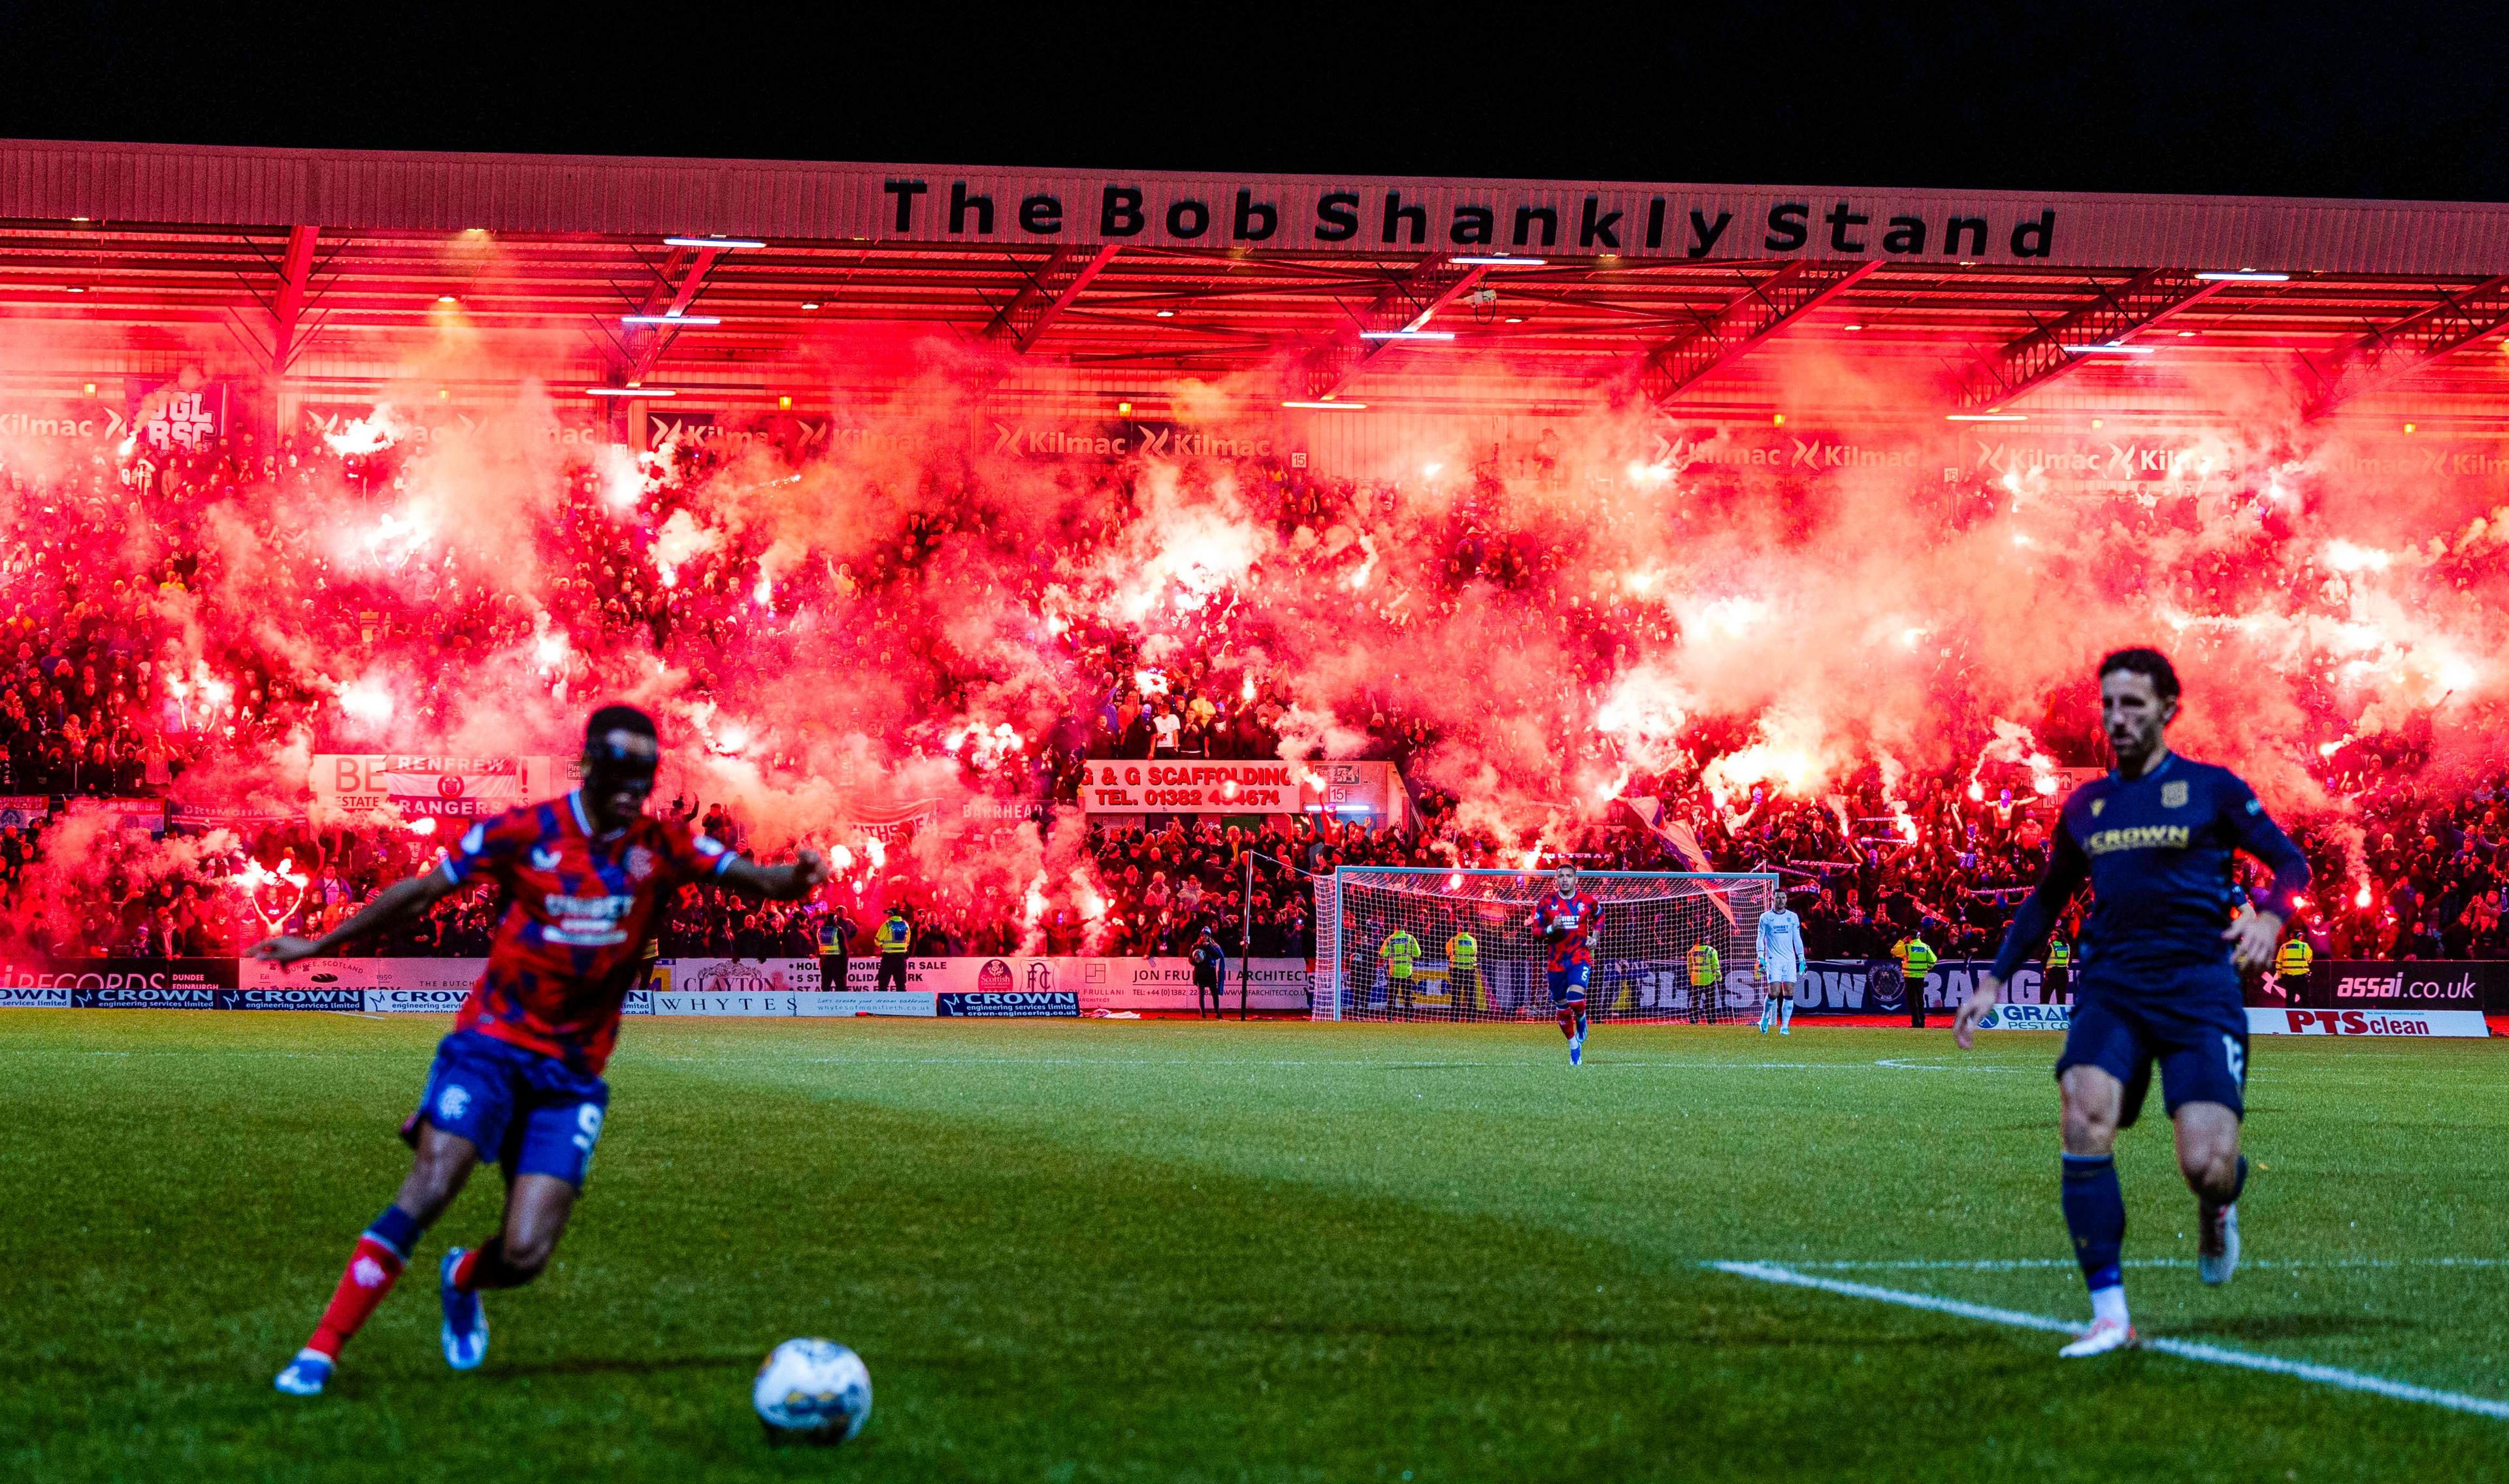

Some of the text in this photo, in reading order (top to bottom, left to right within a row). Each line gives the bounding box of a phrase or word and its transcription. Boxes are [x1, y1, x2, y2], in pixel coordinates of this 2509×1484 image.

[883, 178, 2056, 258] The Bob Shankly Stand
[1029, 432, 1126, 456] Kilmac
[1175, 434, 1271, 457] Kilmac
[1293, 455, 1305, 466] 15
[1689, 443, 1781, 465] Kilmac
[1825, 445, 1920, 468] Kilmac
[2010, 449, 2100, 471] Kilmac
[2453, 454, 2509, 476] Kilm
[398, 756, 508, 772] RENFREW
[1102, 767, 1119, 786] &
[1124, 767, 1140, 786] G
[1148, 767, 1294, 786] SCAFFOLDING
[336, 796, 379, 808] ESTATE
[1095, 789, 1139, 805] TEL.
[1145, 789, 1202, 806] 01382
[1332, 789, 1344, 800] 15
[398, 799, 502, 815] RANGERS
[963, 801, 1043, 820] BARRHEAD
[322, 961, 364, 975] SCOTLAND
[1134, 970, 1160, 982] JON
[18, 973, 167, 989] RECORDS
[2337, 972, 2476, 999] assai.co.uk
[98, 990, 213, 1001] CROWN
[244, 990, 360, 1002] CROWN
[391, 990, 473, 1002] CROW
[964, 992, 1075, 1004] CROWN
[1161, 988, 1170, 997] (0)
[661, 998, 797, 1010] WHYTES
[572, 1103, 604, 1150] 9
